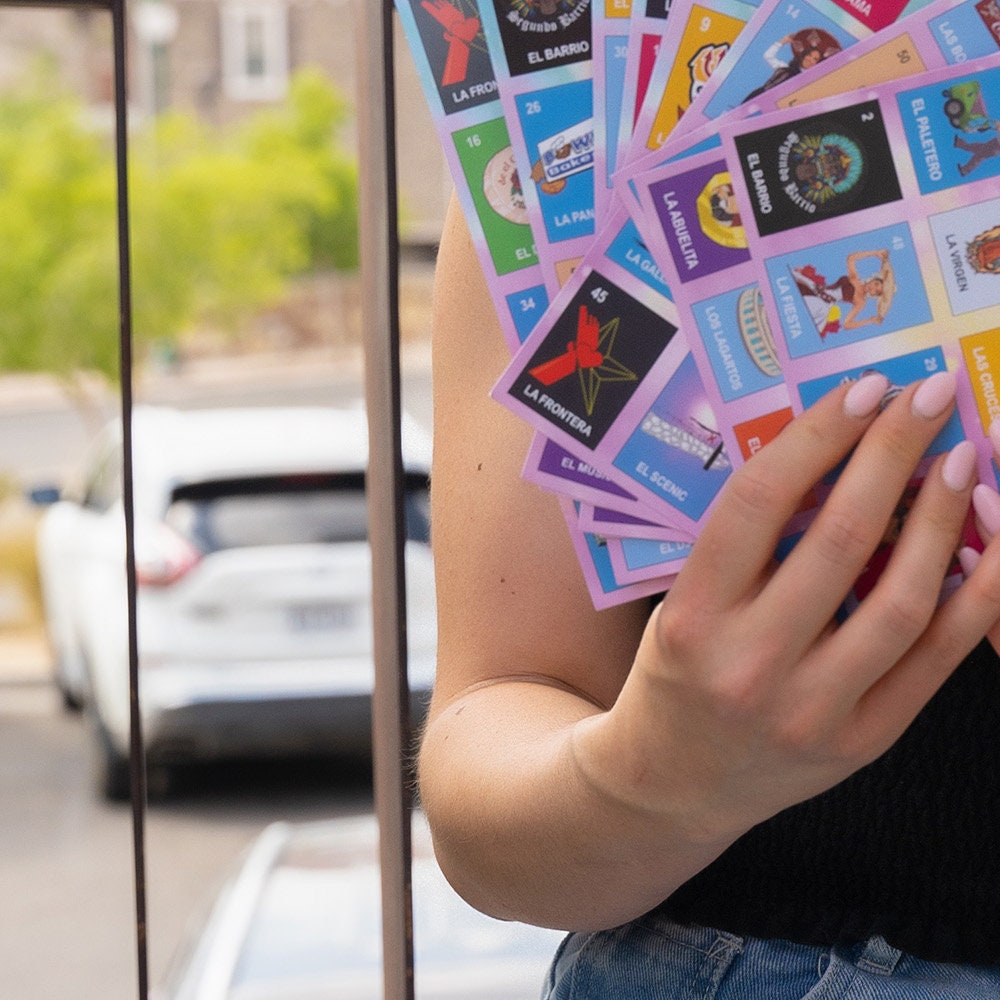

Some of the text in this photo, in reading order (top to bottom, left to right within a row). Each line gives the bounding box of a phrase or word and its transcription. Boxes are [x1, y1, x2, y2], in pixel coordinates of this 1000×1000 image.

[786, 3, 801, 19] 14
[700, 17, 711, 32] 9
[527, 40, 590, 64] EL BARRIO
[452, 89, 469, 103] LA
[525, 101, 542, 115] 26
[861, 111, 874, 122] 2
[466, 134, 481, 148] 16
[911, 98, 943, 181] EL PALETERO
[747, 153, 773, 214] EL BARRIO
[554, 214, 571, 227] LA
[662, 191, 700, 271] LA ABUELITA
[625, 249, 640, 265] LA
[945, 234, 968, 292] LA VIRGEN
[775, 276, 790, 295] LA
[590, 287, 609, 303] 45
[520, 297, 536, 312] 34
[704, 305, 721, 328] LOS
[972, 346, 989, 371] LAS
[523, 384, 593, 437] LA FRONTERA
[561, 457, 576, 471] EL
[636, 461, 689, 502] EL SCENIC
